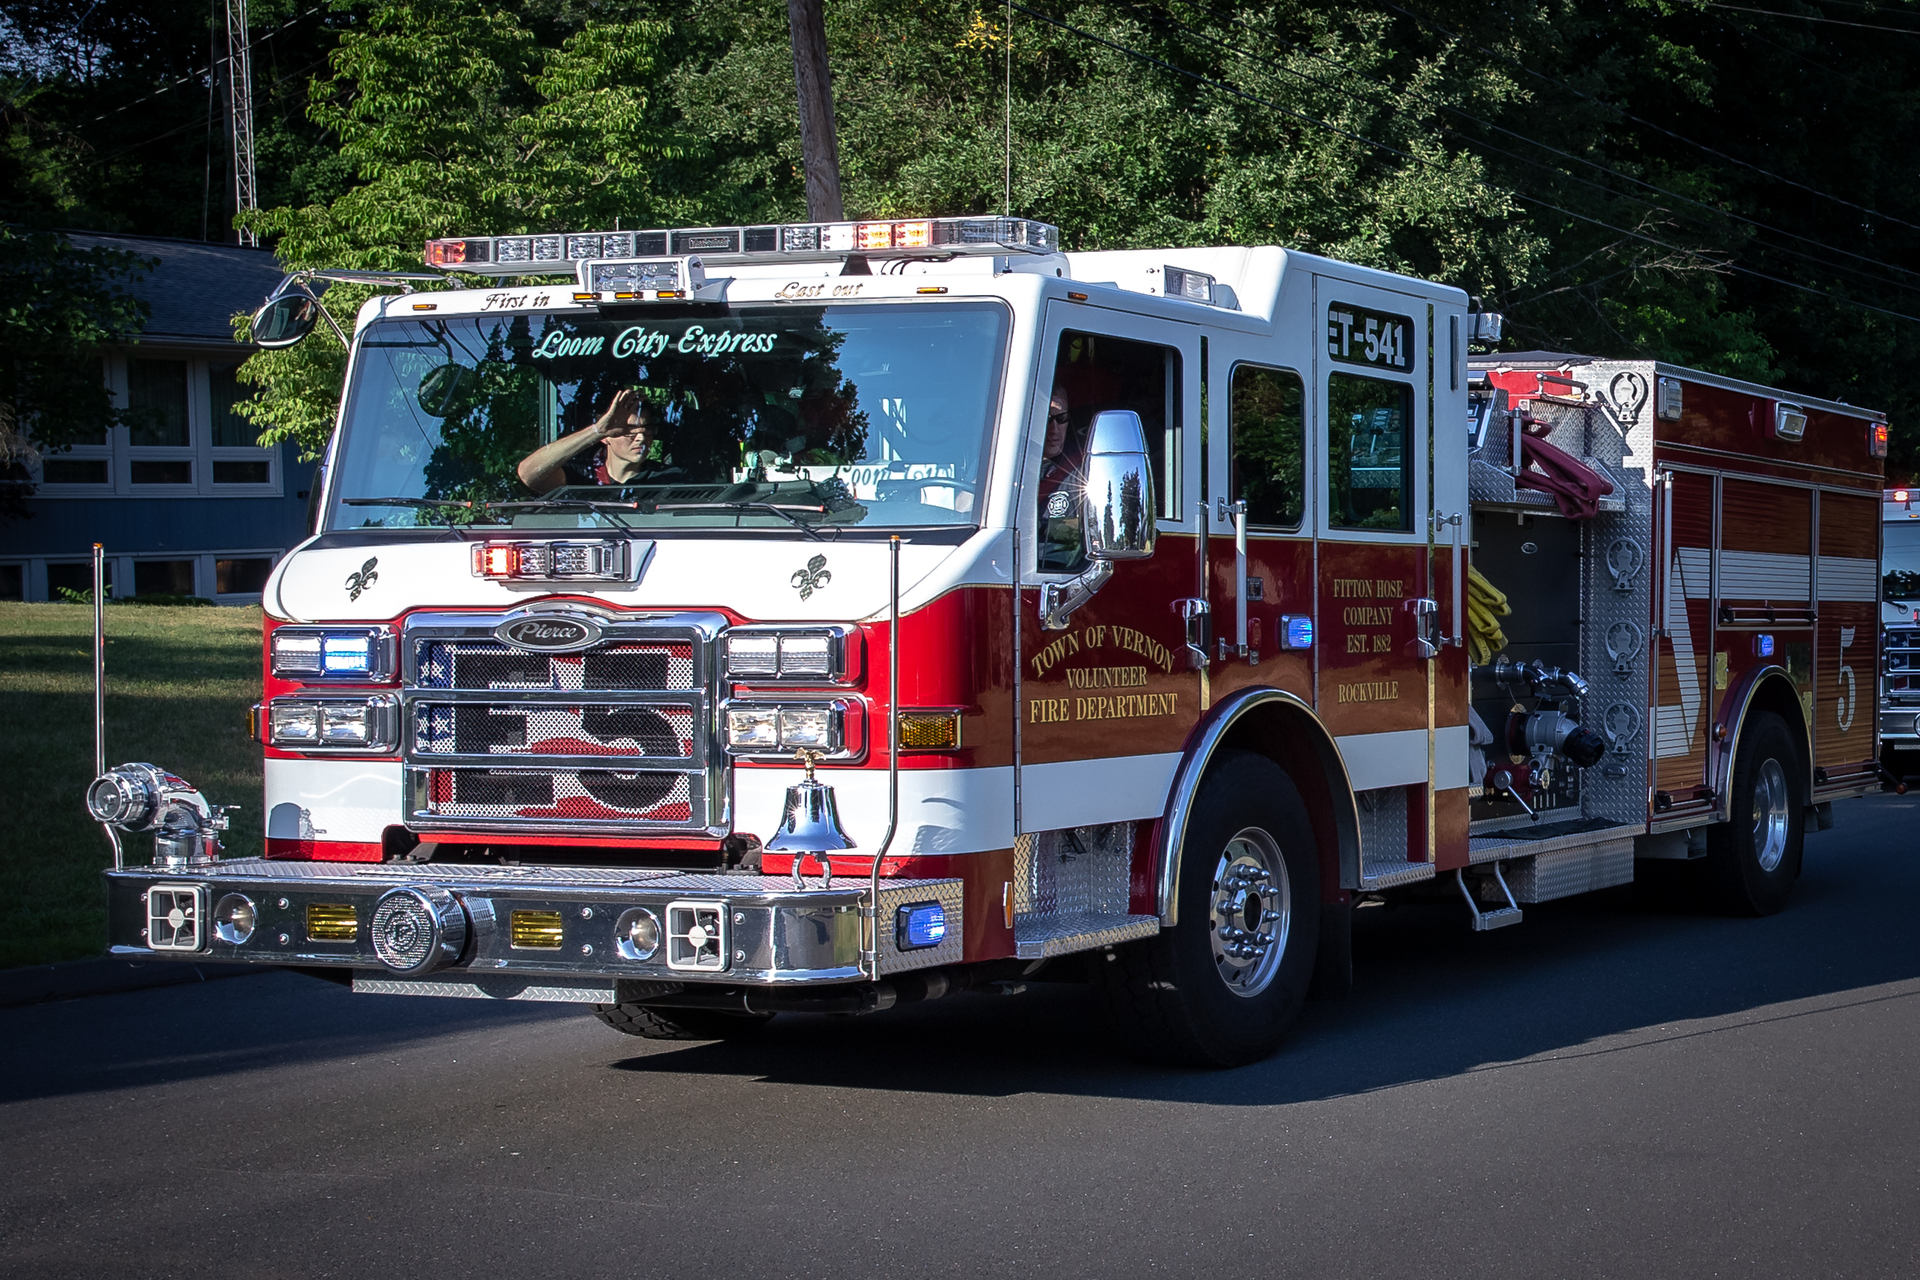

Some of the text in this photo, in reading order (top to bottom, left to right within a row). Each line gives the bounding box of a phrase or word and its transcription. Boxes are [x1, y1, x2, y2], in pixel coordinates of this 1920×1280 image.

[774, 282, 863, 298] Last out
[480, 291, 551, 311] First in
[532, 325, 777, 358] Loom City Express
[1333, 579, 1403, 598] FITTON HOSE
[1343, 606, 1393, 626] COMPANY
[517, 622, 578, 641] Pierce
[1031, 625, 1175, 678] TOWN OF VERNON
[1347, 634, 1392, 653] EST. 1882
[1066, 666, 1148, 690] VOLUNTEER
[1837, 625, 1856, 731] 5
[1338, 681, 1399, 703] ROCKVILLE
[1030, 693, 1178, 724] FIRE DEPARTMENT
